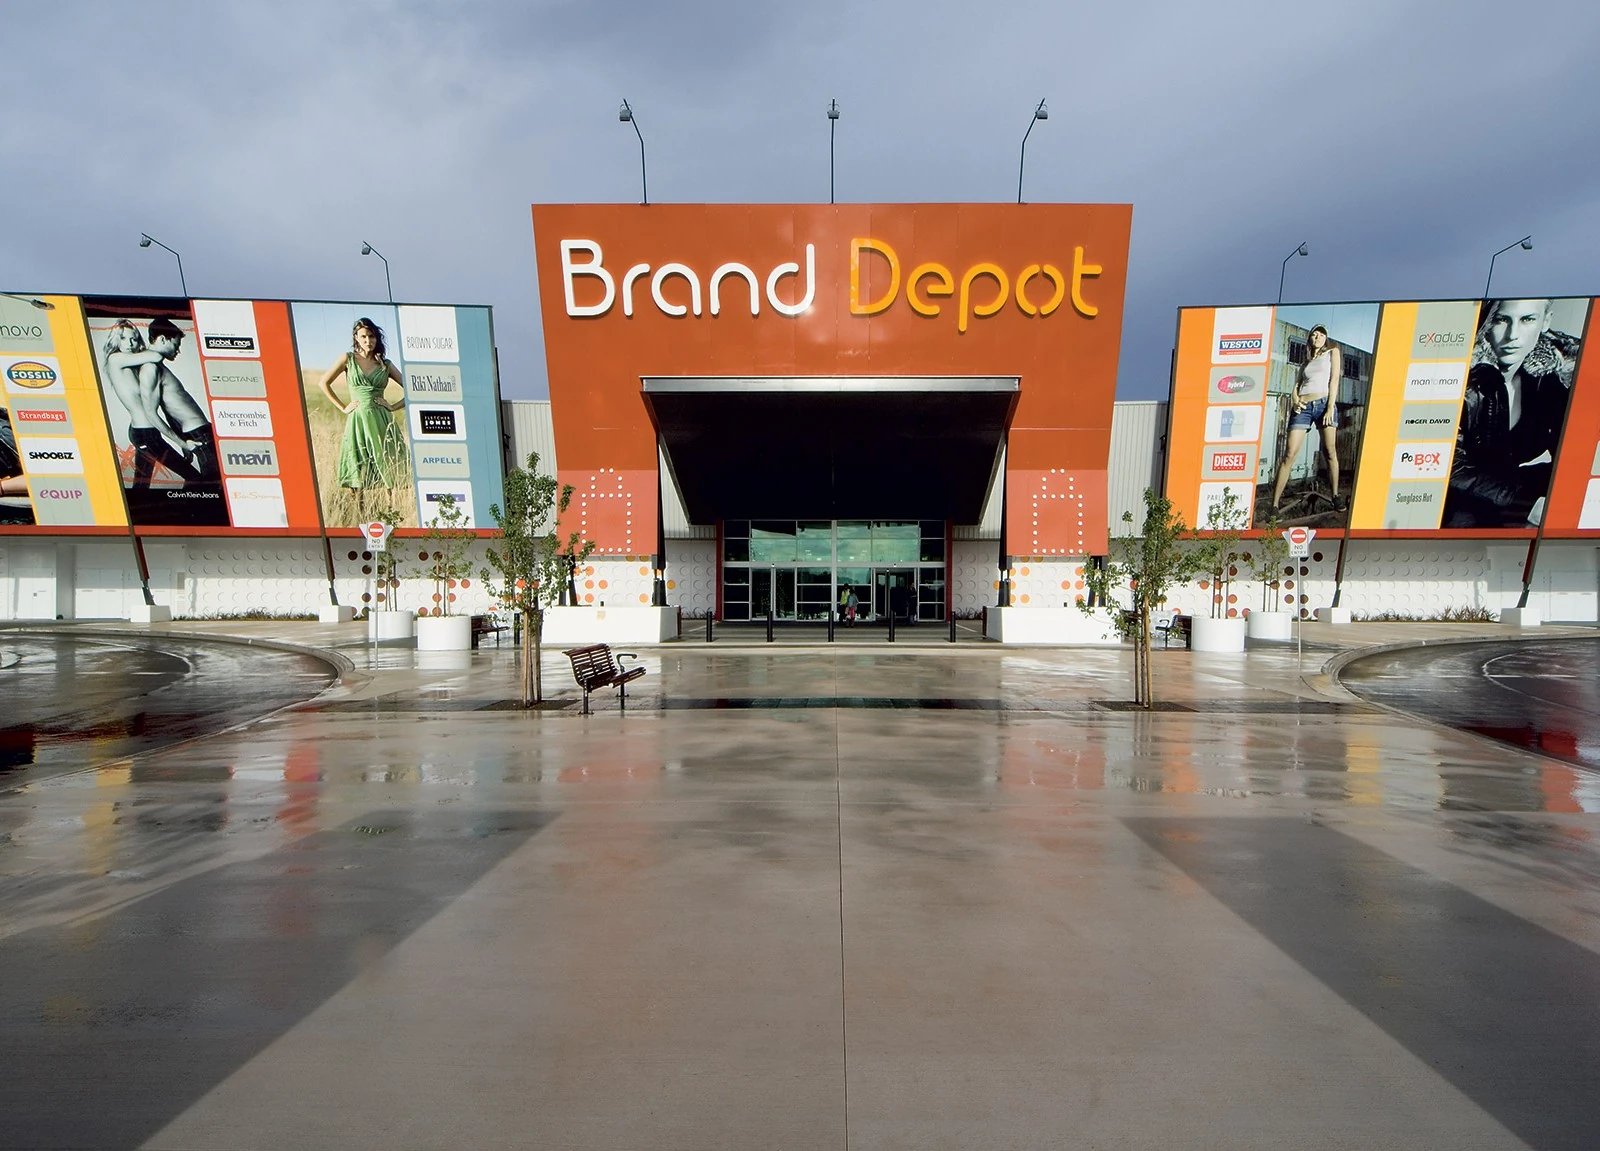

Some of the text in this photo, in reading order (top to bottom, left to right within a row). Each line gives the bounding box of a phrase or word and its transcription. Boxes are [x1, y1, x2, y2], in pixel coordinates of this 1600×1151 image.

[559, 238, 1103, 332] Brand Depot
[407, 336, 453, 350] BROWN SUGAR
[1221, 340, 1260, 349] WESTCO
[11, 371, 54, 379] FOSSIL
[411, 375, 426, 391] Riki
[427, 375, 452, 392] Nathan
[20, 412, 64, 421] Strandbags
[218, 411, 267, 419] Abercrombie
[238, 419, 258, 427] Fitch
[227, 450, 272, 465] mavi
[1214, 455, 1244, 467] DIESEL
[166, 490, 186, 499] Calvin
[202, 491, 219, 499] Jeans
[1396, 493, 1422, 504] Sunglass
